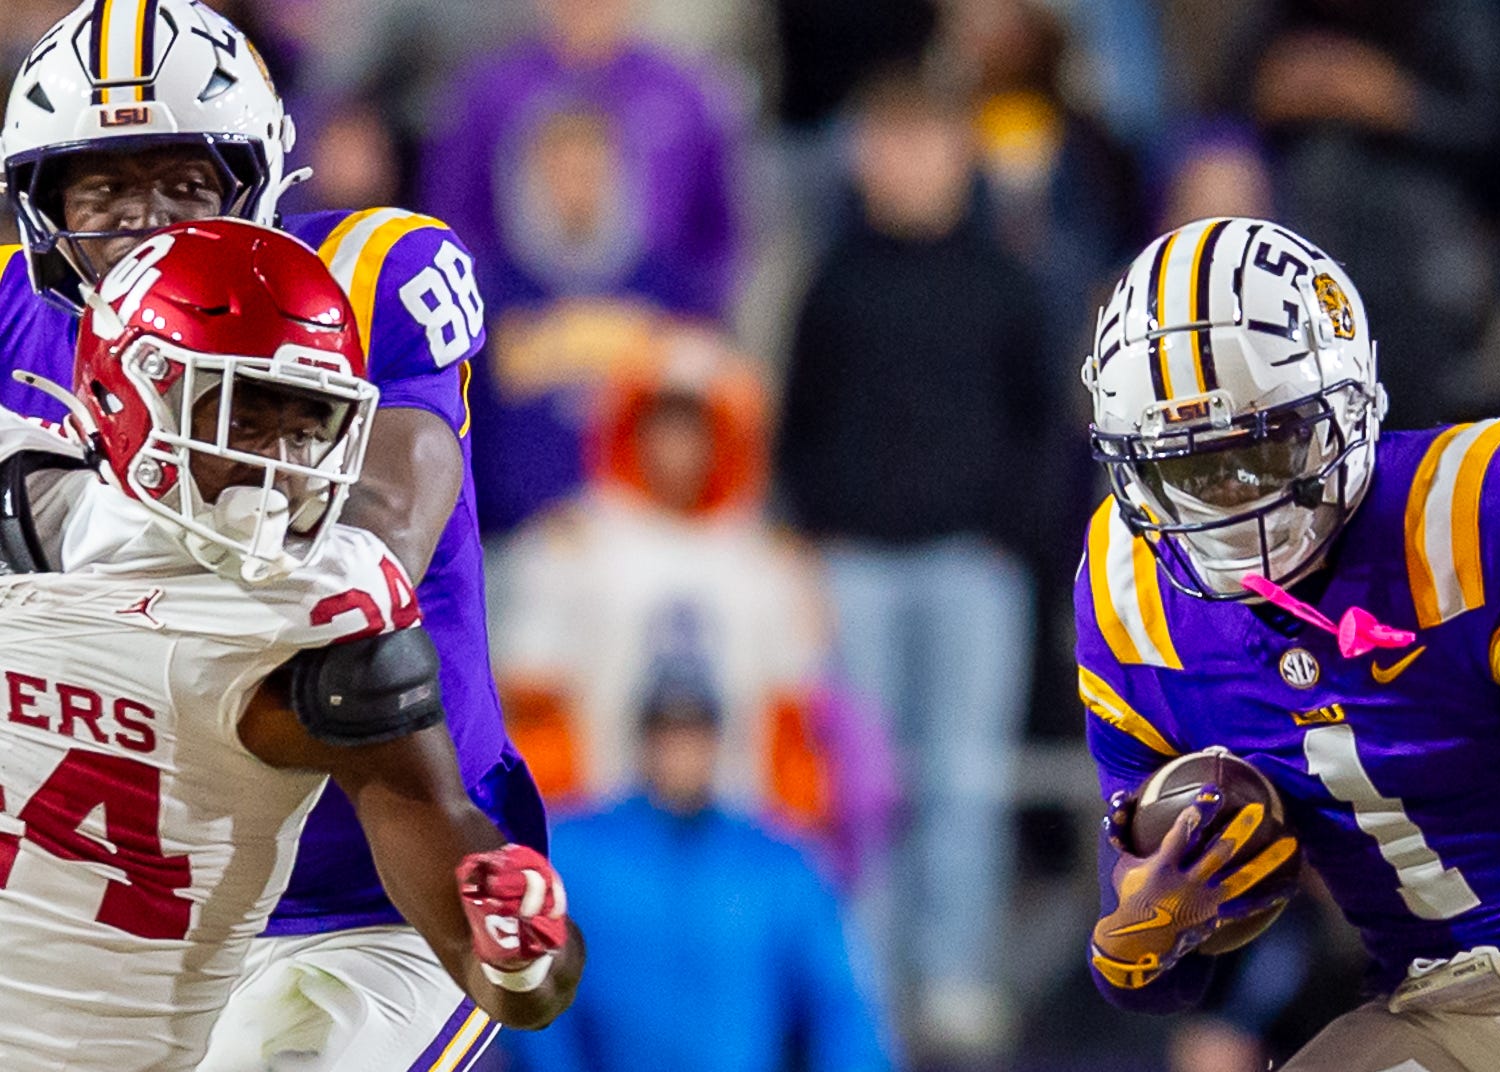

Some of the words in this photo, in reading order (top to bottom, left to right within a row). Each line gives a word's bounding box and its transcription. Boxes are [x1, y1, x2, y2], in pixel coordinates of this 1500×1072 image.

[99, 106, 150, 128] LSU
[398, 239, 486, 369] 88
[0, 745, 194, 941] 4
[1302, 723, 1483, 921] 1
